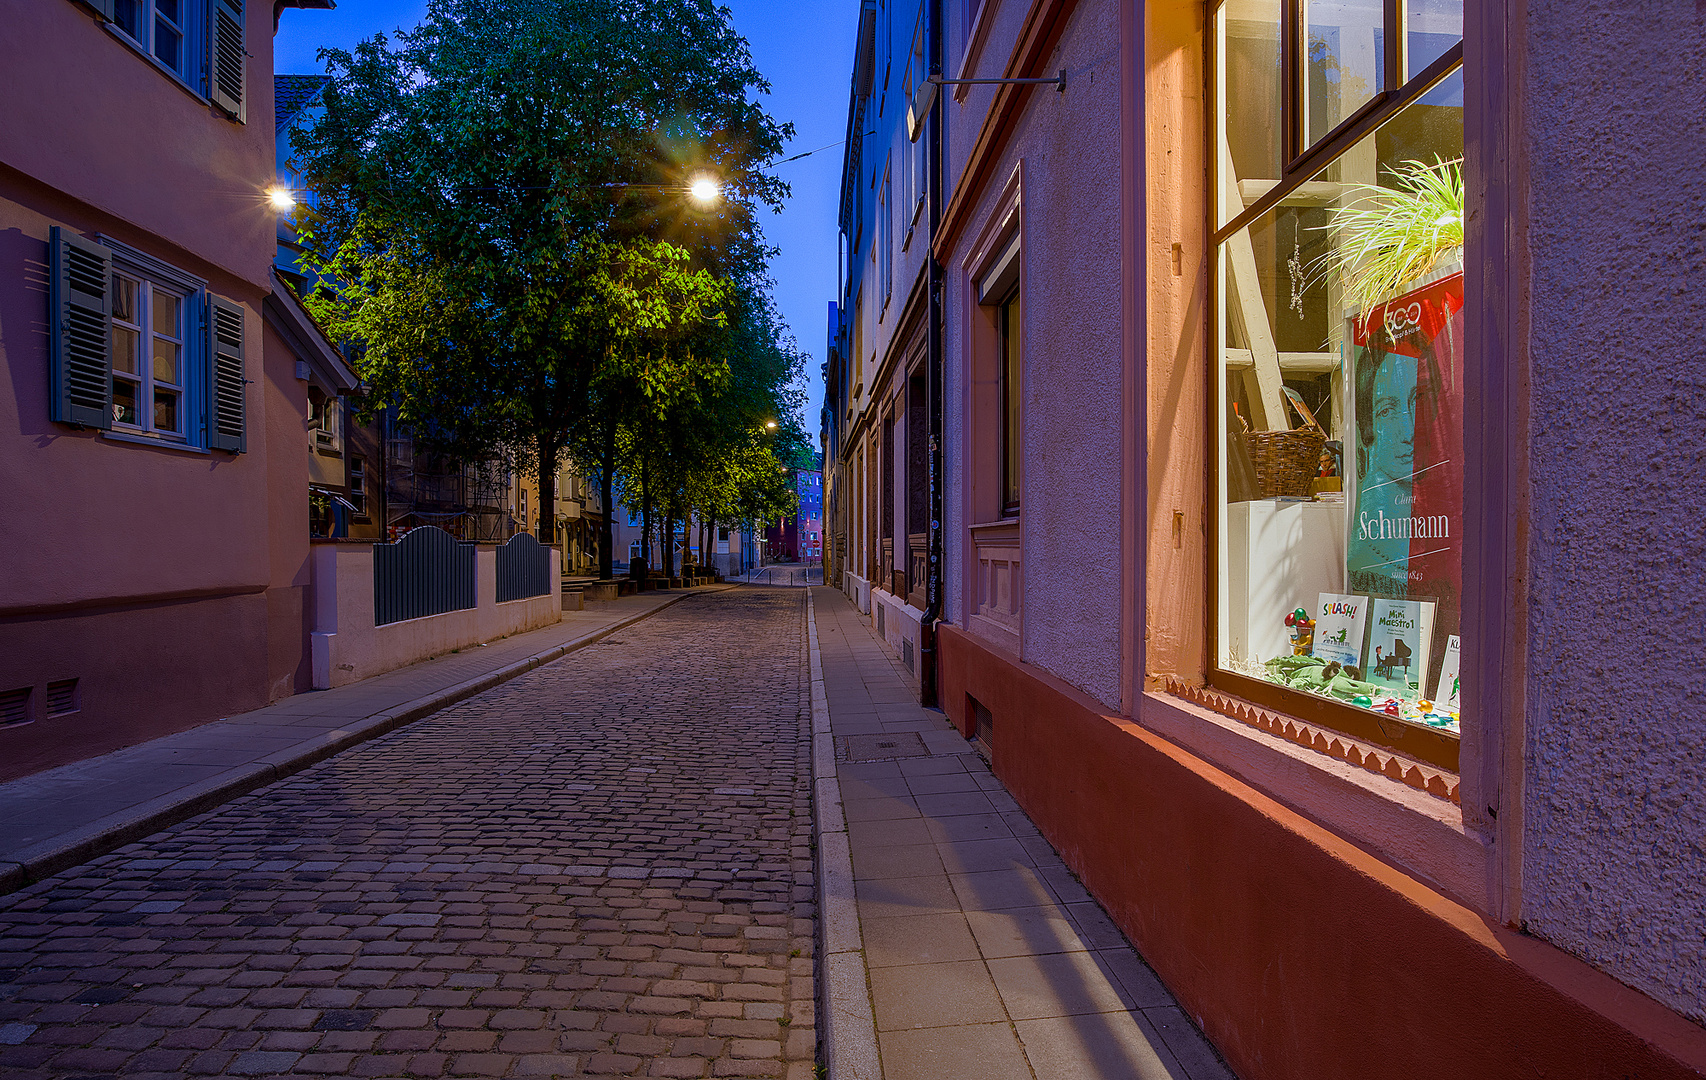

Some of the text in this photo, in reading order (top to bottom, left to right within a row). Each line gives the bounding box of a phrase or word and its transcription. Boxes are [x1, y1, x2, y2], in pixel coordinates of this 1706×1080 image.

[1395, 493, 1416, 505] Clara
[1360, 510, 1449, 540] Schumann
[1323, 602, 1357, 619] SPLASH!
[1388, 610, 1405, 619] Mini
[1378, 616, 1410, 629] Maestro
